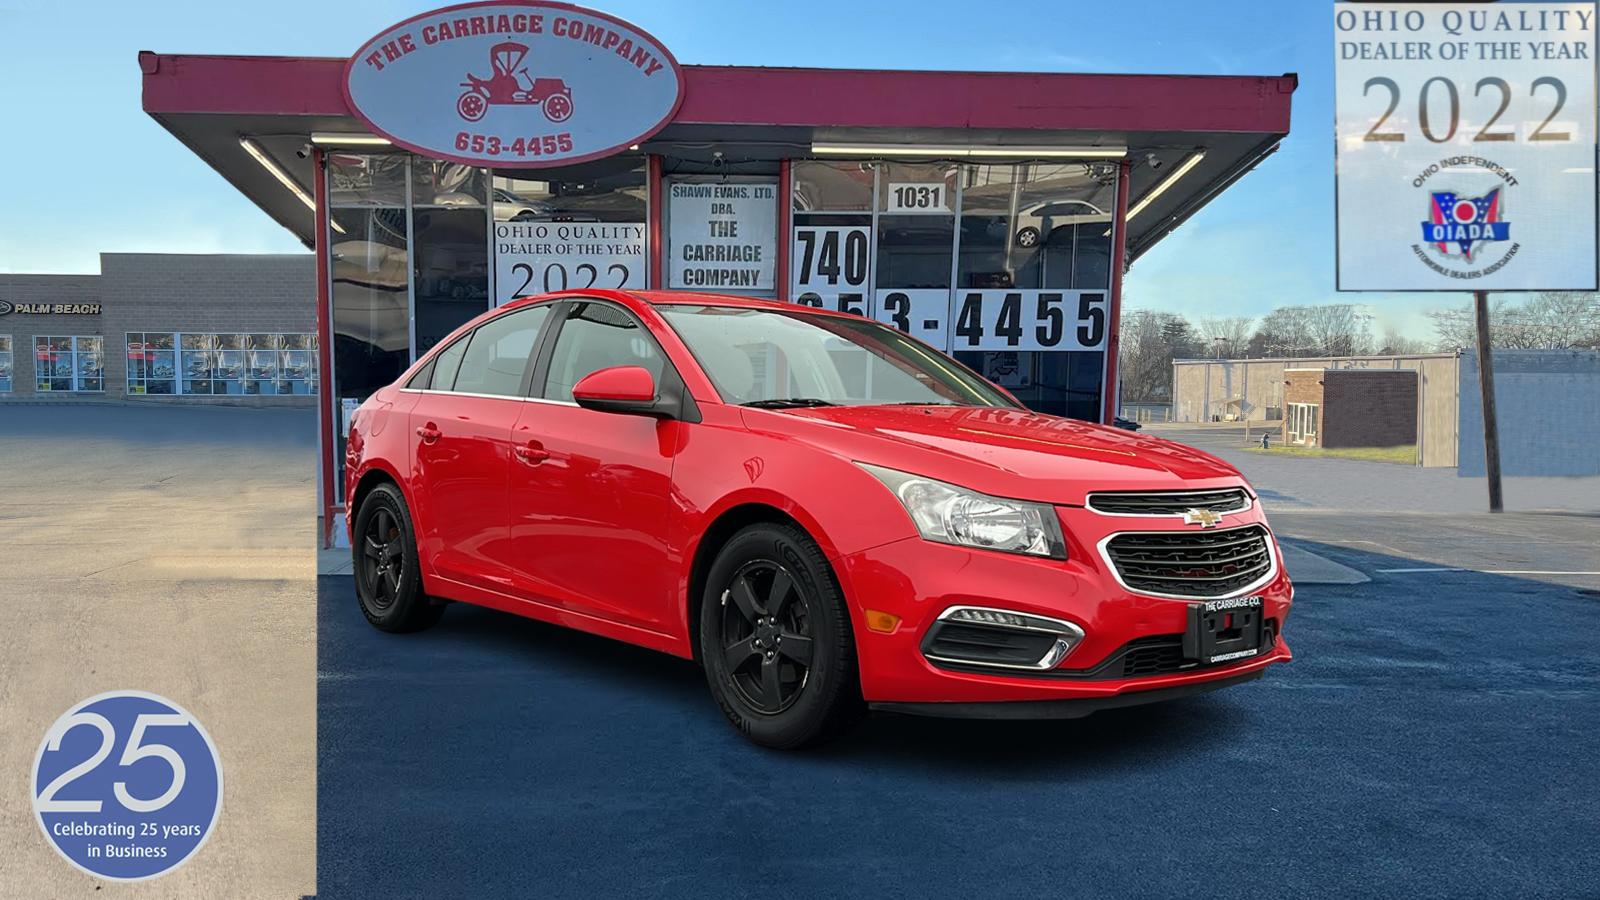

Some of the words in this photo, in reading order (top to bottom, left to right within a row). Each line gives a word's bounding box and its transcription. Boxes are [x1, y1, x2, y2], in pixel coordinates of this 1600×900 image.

[1336, 10, 1425, 32] OHIO
[1442, 10, 1592, 36] QUALITY
[366, 33, 416, 72] THE
[422, 14, 544, 45] CARRIAGE
[553, 17, 663, 77] COMPANY
[1340, 42, 1433, 60] DEALER
[1439, 42, 1469, 60] OF
[1475, 42, 1521, 60] THE
[1528, 42, 1589, 60] YEAR
[1362, 76, 1571, 143] 2022
[455, 132, 573, 157] 653-4455
[1412, 163, 1440, 188] OHIO
[1440, 155, 1520, 188] INDEPENDENT
[672, 186, 712, 199] SHAWN
[894, 186, 940, 208] 1031
[711, 203, 736, 215] DBA.
[497, 226, 548, 239] OHIO
[558, 226, 644, 241] QUALITY
[708, 221, 738, 238] THE
[1432, 224, 1495, 240] OIADA
[500, 244, 552, 255] DEALER
[555, 244, 574, 255] OF
[576, 244, 603, 255] THE
[605, 244, 641, 255] YEAR
[683, 245, 762, 262] CARRIAGE
[797, 230, 867, 286] 740
[511, 263, 630, 299] 2022
[683, 269, 760, 286] COMPANY
[15, 304, 50, 313] PALM
[1205, 602, 1217, 612] THE
[1216, 597, 1249, 610] CARRIAGE
